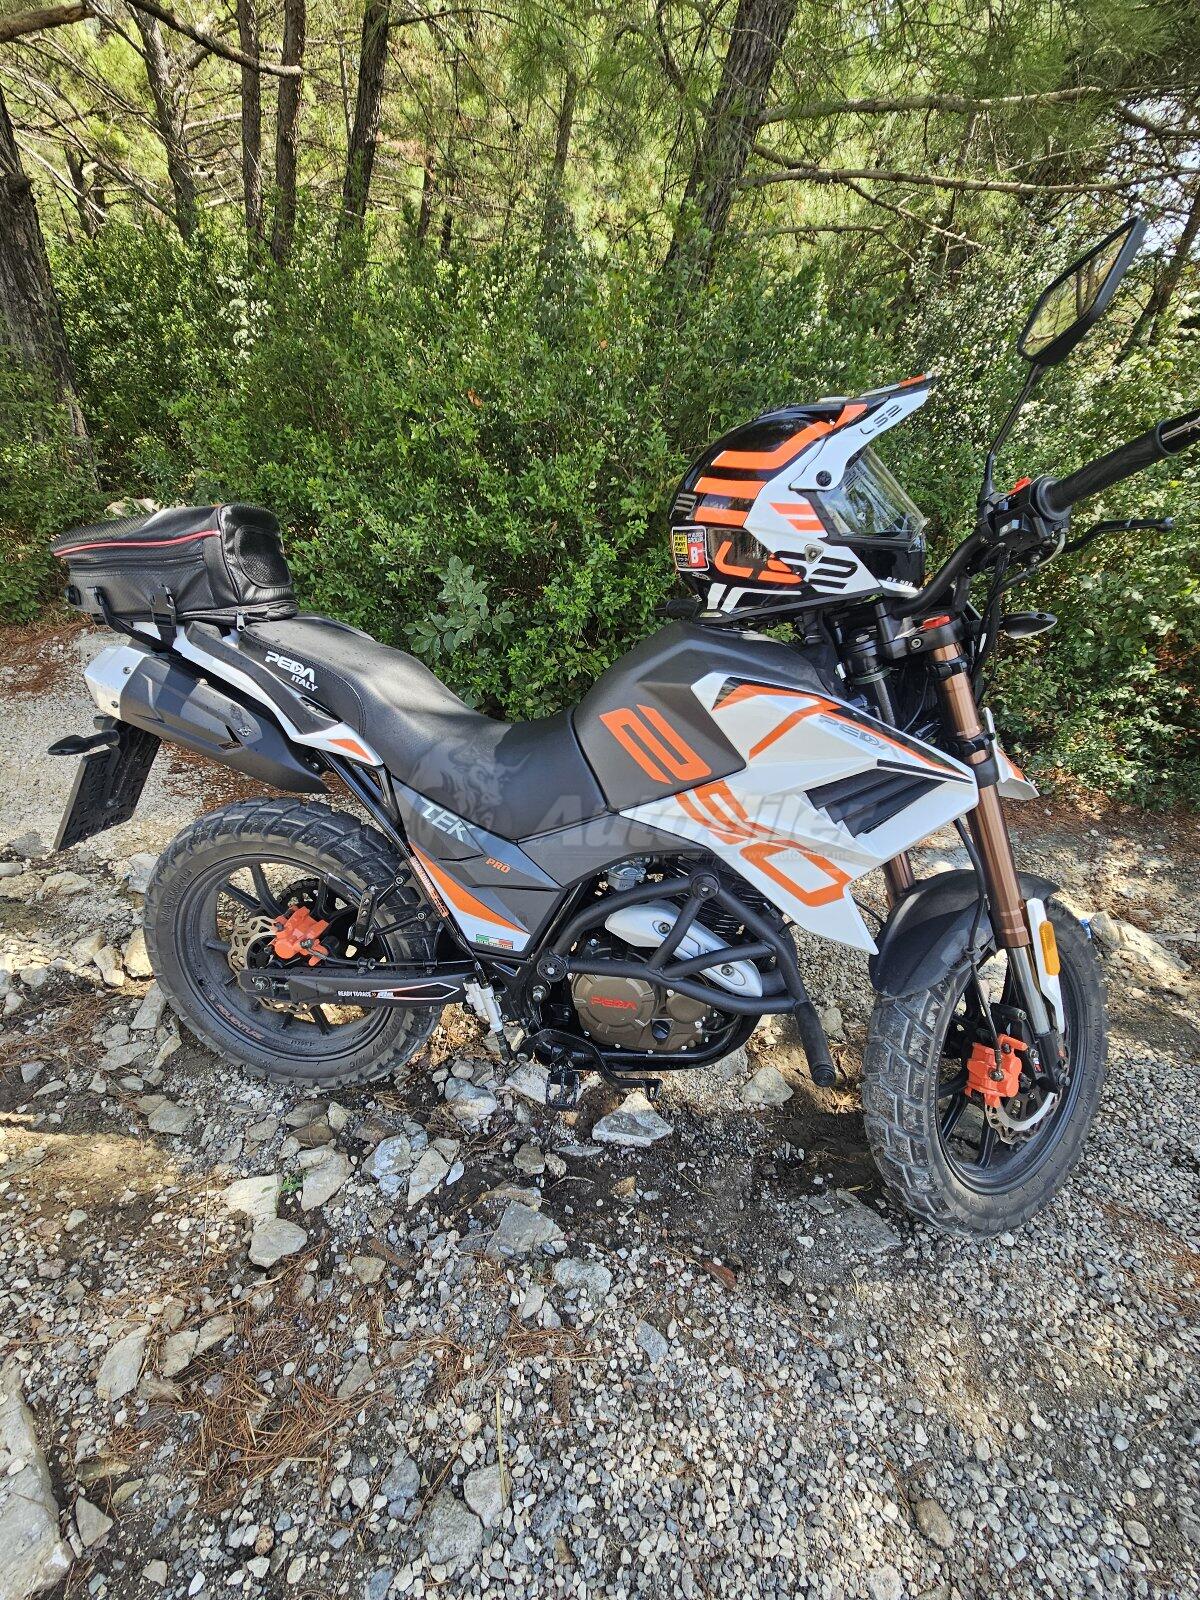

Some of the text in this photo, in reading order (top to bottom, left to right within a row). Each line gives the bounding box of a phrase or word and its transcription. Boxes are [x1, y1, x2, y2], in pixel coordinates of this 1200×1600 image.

[859, 404, 903, 435] LS2
[264, 650, 315, 683] PEDA
[291, 674, 319, 692] ITALY
[818, 714, 900, 759] PEDA
[420, 796, 476, 842] TEK
[484, 857, 512, 874] PRO
